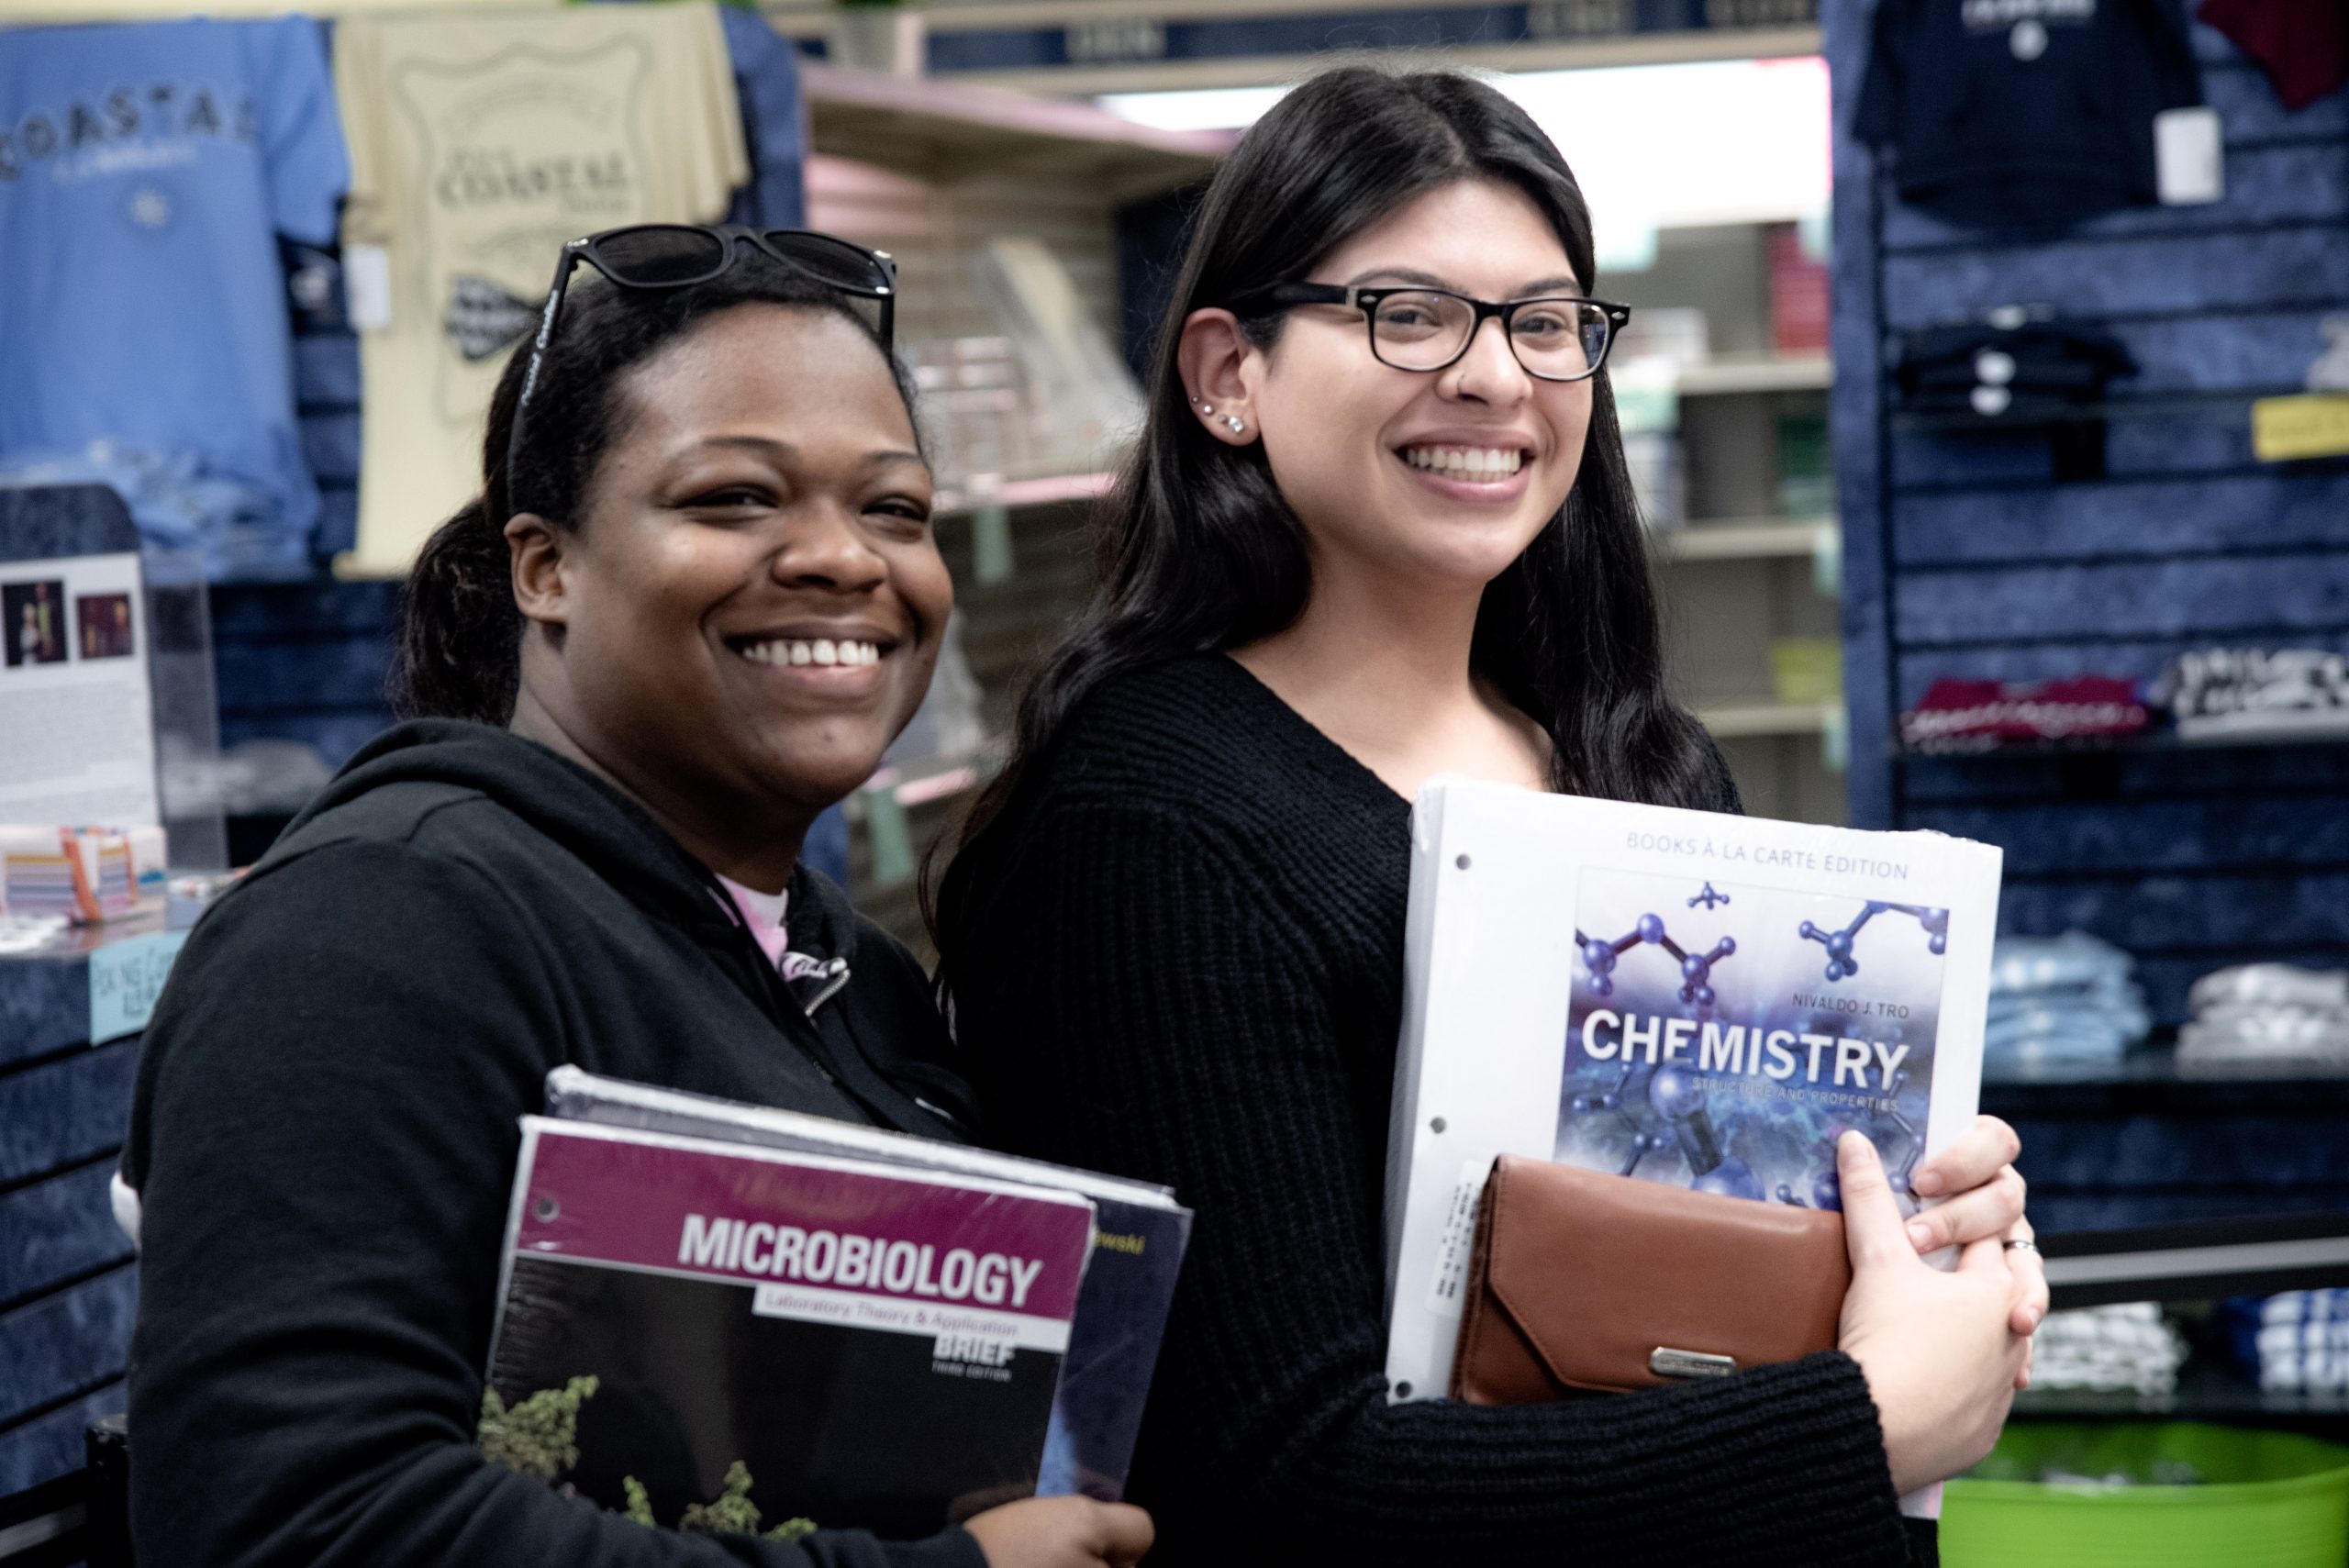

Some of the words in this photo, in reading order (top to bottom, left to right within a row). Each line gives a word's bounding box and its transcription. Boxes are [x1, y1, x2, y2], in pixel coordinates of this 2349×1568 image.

[1627, 831, 1696, 855] BOOKS
[1702, 836, 1716, 857] À
[1722, 843, 1746, 862] LA
[1823, 855, 1909, 880] EDITION
[1792, 994, 1858, 1013] NIVALDO
[1863, 1001, 1873, 1015] J.
[1877, 1003, 1909, 1019] TRO
[1582, 1009, 1909, 1091] CHEMISTRY
[1691, 1076, 1773, 1097] STRUCTURE
[1776, 1086, 1806, 1101] AND
[1810, 1091, 1900, 1112] PROPERTIES
[678, 1213, 1044, 1307] MICROBIOLOGY
[1096, 1231, 1145, 1255] ewski
[764, 1290, 852, 1318] Laboratory
[857, 1301, 909, 1325] Theory
[917, 1309, 928, 1324] &
[931, 1313, 1019, 1337] Application
[932, 1333, 1016, 1367] BRIEF
[966, 1363, 1013, 1383] EDITION
